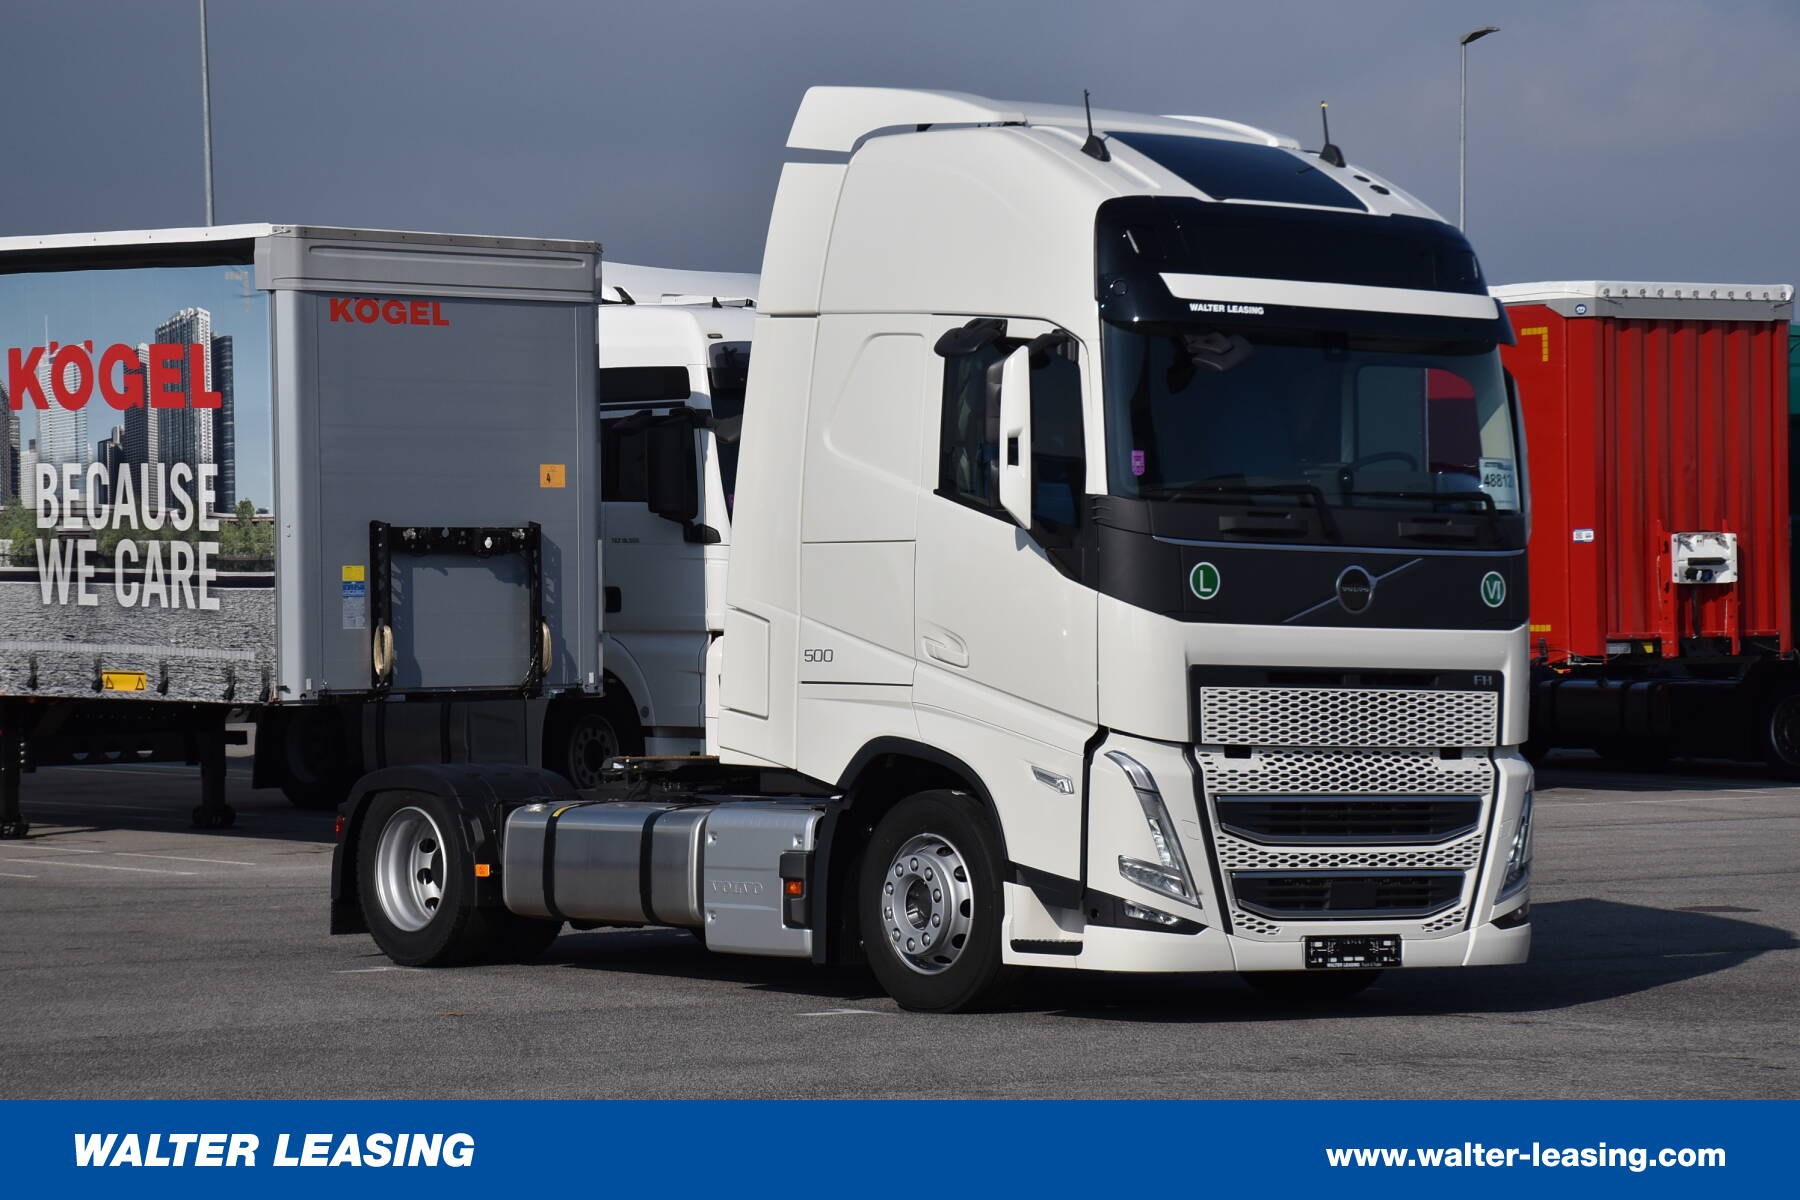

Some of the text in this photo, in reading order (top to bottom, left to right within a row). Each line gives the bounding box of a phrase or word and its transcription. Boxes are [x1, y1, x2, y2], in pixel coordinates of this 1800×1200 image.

[329, 297, 449, 326] KÖGEL
[1189, 303, 1264, 315] WALTER LEASING
[8, 340, 222, 410] KÖGEL
[36, 462, 220, 531] BECAUSE
[35, 538, 220, 611] WE CARE
[1200, 570, 1212, 592] L
[1486, 580, 1501, 600] VI
[804, 649, 834, 662] 500
[1474, 675, 1493, 685] FH
[712, 880, 765, 895] VOLVO
